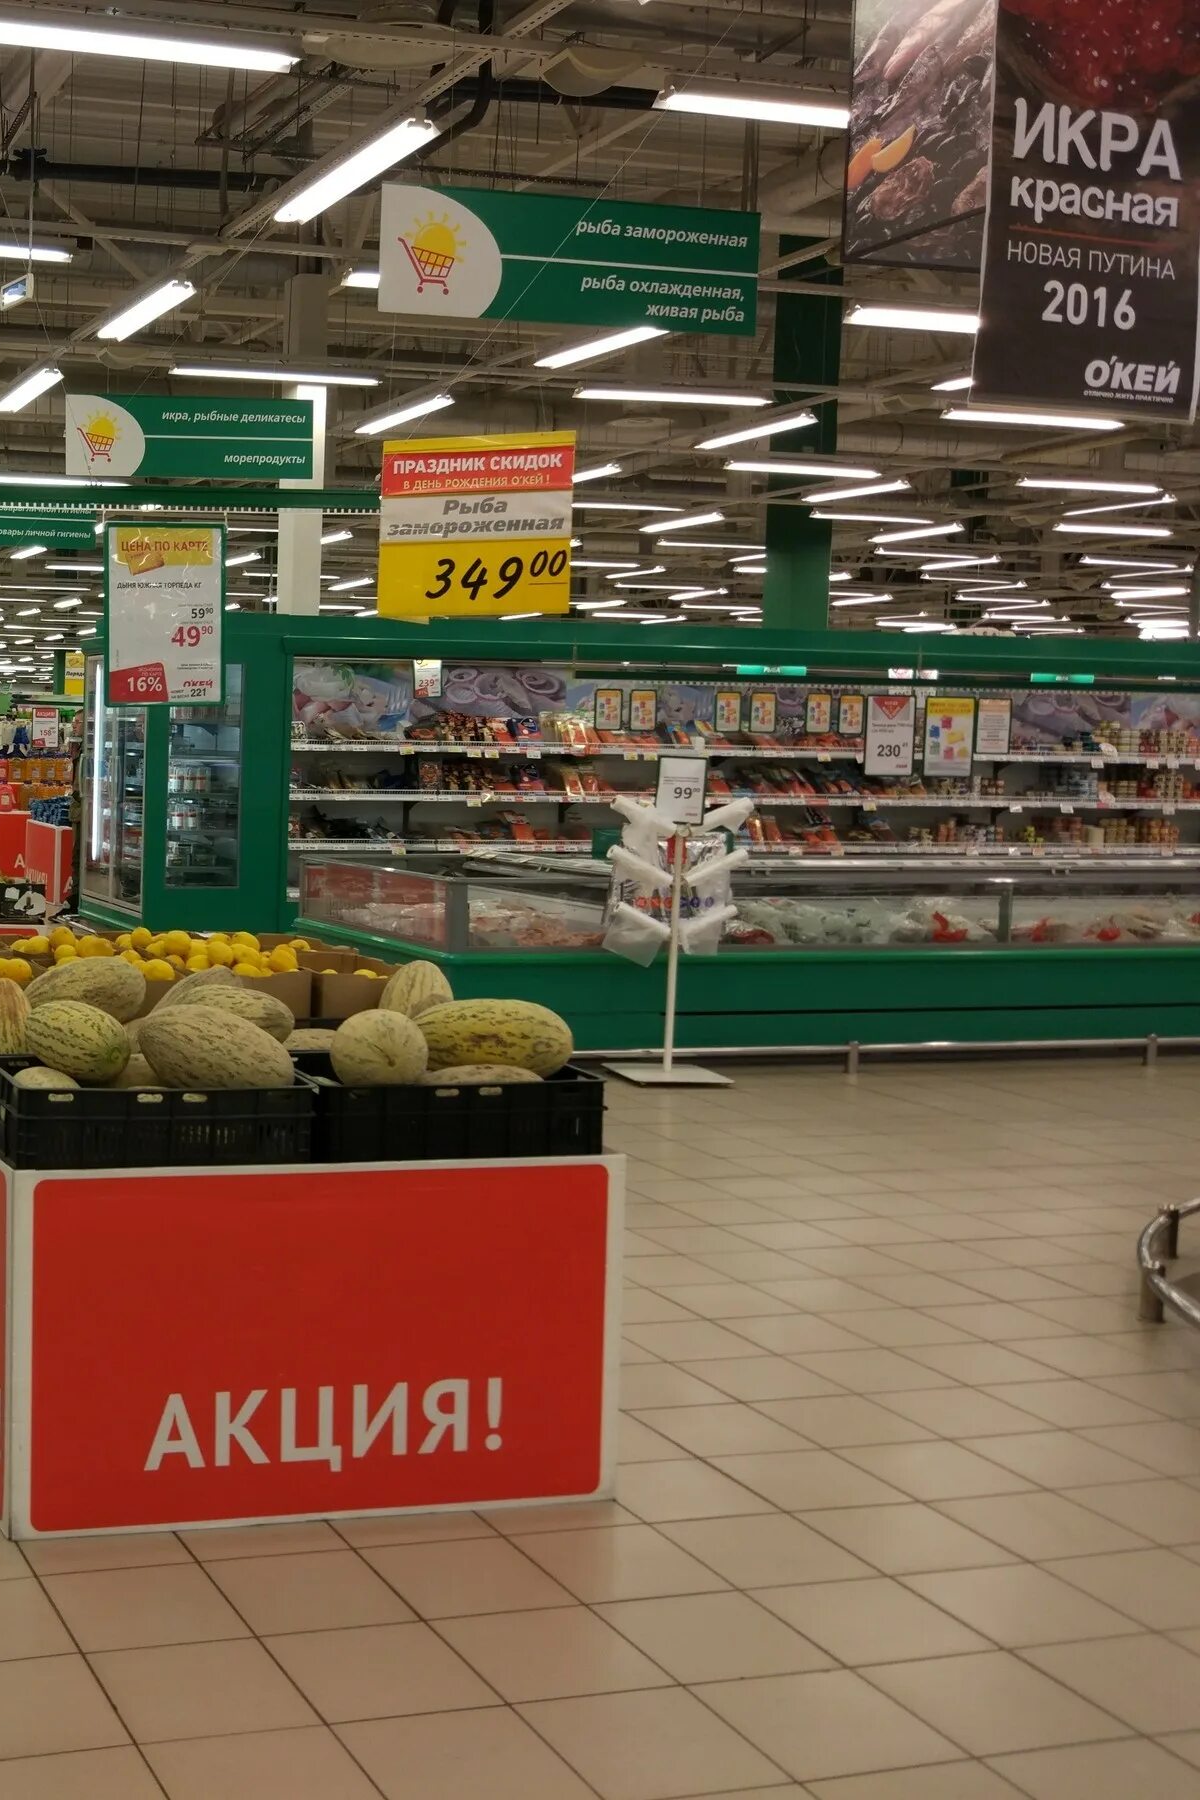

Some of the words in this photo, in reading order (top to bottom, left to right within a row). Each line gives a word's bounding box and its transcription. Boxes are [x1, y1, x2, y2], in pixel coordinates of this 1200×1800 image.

[1011, 97, 1182, 181] ИКРА
[1010, 176, 1179, 228] красная
[576, 219, 620, 236] рыба
[624, 225, 748, 248] замороженная
[1007, 240, 1081, 269] НОВАЯ
[1088, 250, 1176, 280] ПУТИНА
[580, 274, 626, 292] рыба
[629, 280, 745, 301] охлажденная,
[645, 303, 698, 319] живая
[701, 306, 745, 323] рыба
[1042, 279, 1136, 330] 2016
[162, 410, 191, 422] икра,
[194, 410, 239, 423] рыбные
[240, 412, 306, 424] деликатесы
[224, 454, 306, 466] морепродукты
[393, 457, 486, 475] ПРАЗДНИК
[490, 453, 563, 471] СКИДОК
[403, 480, 409, 490] В
[412, 479, 442, 491] ДЕНЬ
[445, 476, 508, 489] РОЖДЕНИЯ
[442, 497, 508, 516] Рыба
[24, 529, 56, 537] личной
[57, 531, 91, 539] гигиены
[387, 517, 565, 538] замороженная
[122, 541, 151, 552] ЦЕНА
[154, 541, 170, 551] ПО
[174, 541, 208, 552] КАРТЕ
[127, 676, 163, 692] 16%
[190, 688, 206, 697] 221
[143, 1376, 505, 1474] АКЦИЯ!
